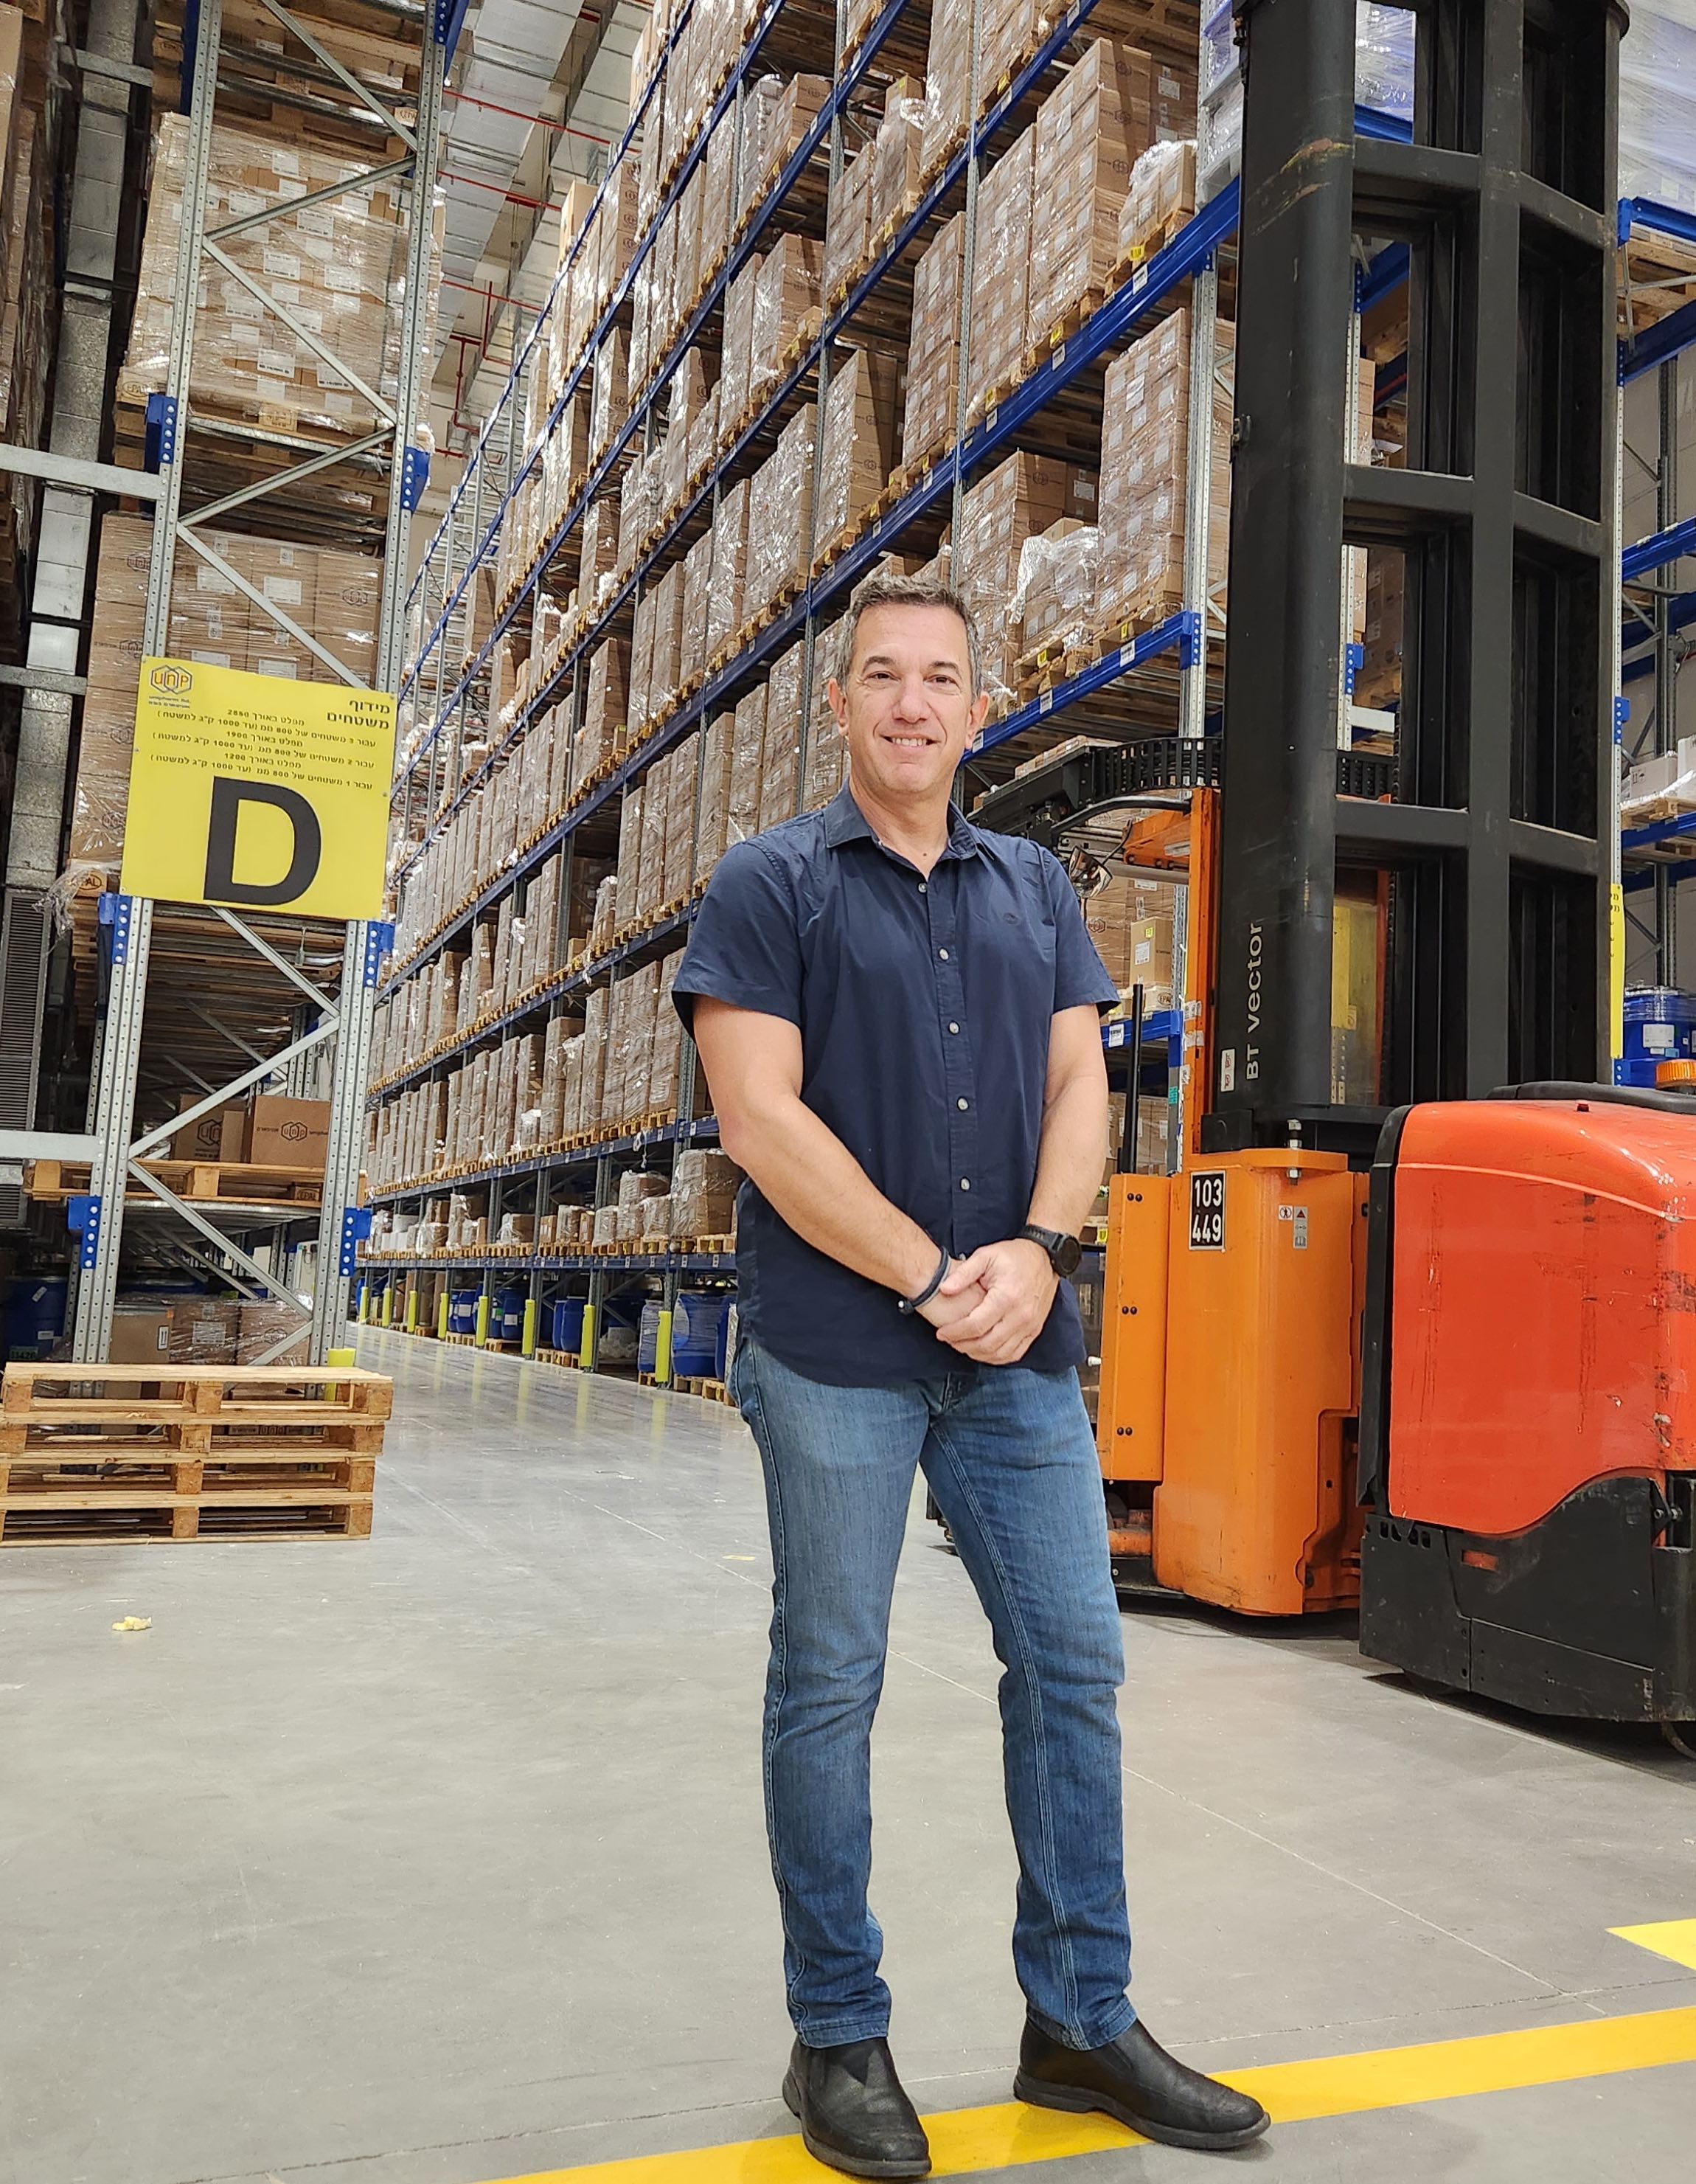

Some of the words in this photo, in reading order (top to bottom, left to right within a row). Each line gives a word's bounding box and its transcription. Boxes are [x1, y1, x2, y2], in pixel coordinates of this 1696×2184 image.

[350, 700, 390, 714] מידוף
[218, 718, 240, 727] 1000
[327, 712, 389, 729] משטחים
[214, 739, 234, 748] 1000
[224, 752, 246, 761] 1200
[211, 762, 233, 770] 1000
[204, 776, 322, 906] D
[1247, 922, 1263, 1025] vector
[1246, 1043, 1259, 1080] BT
[1194, 1179, 1222, 1207] 103
[1192, 1214, 1222, 1244] 449
